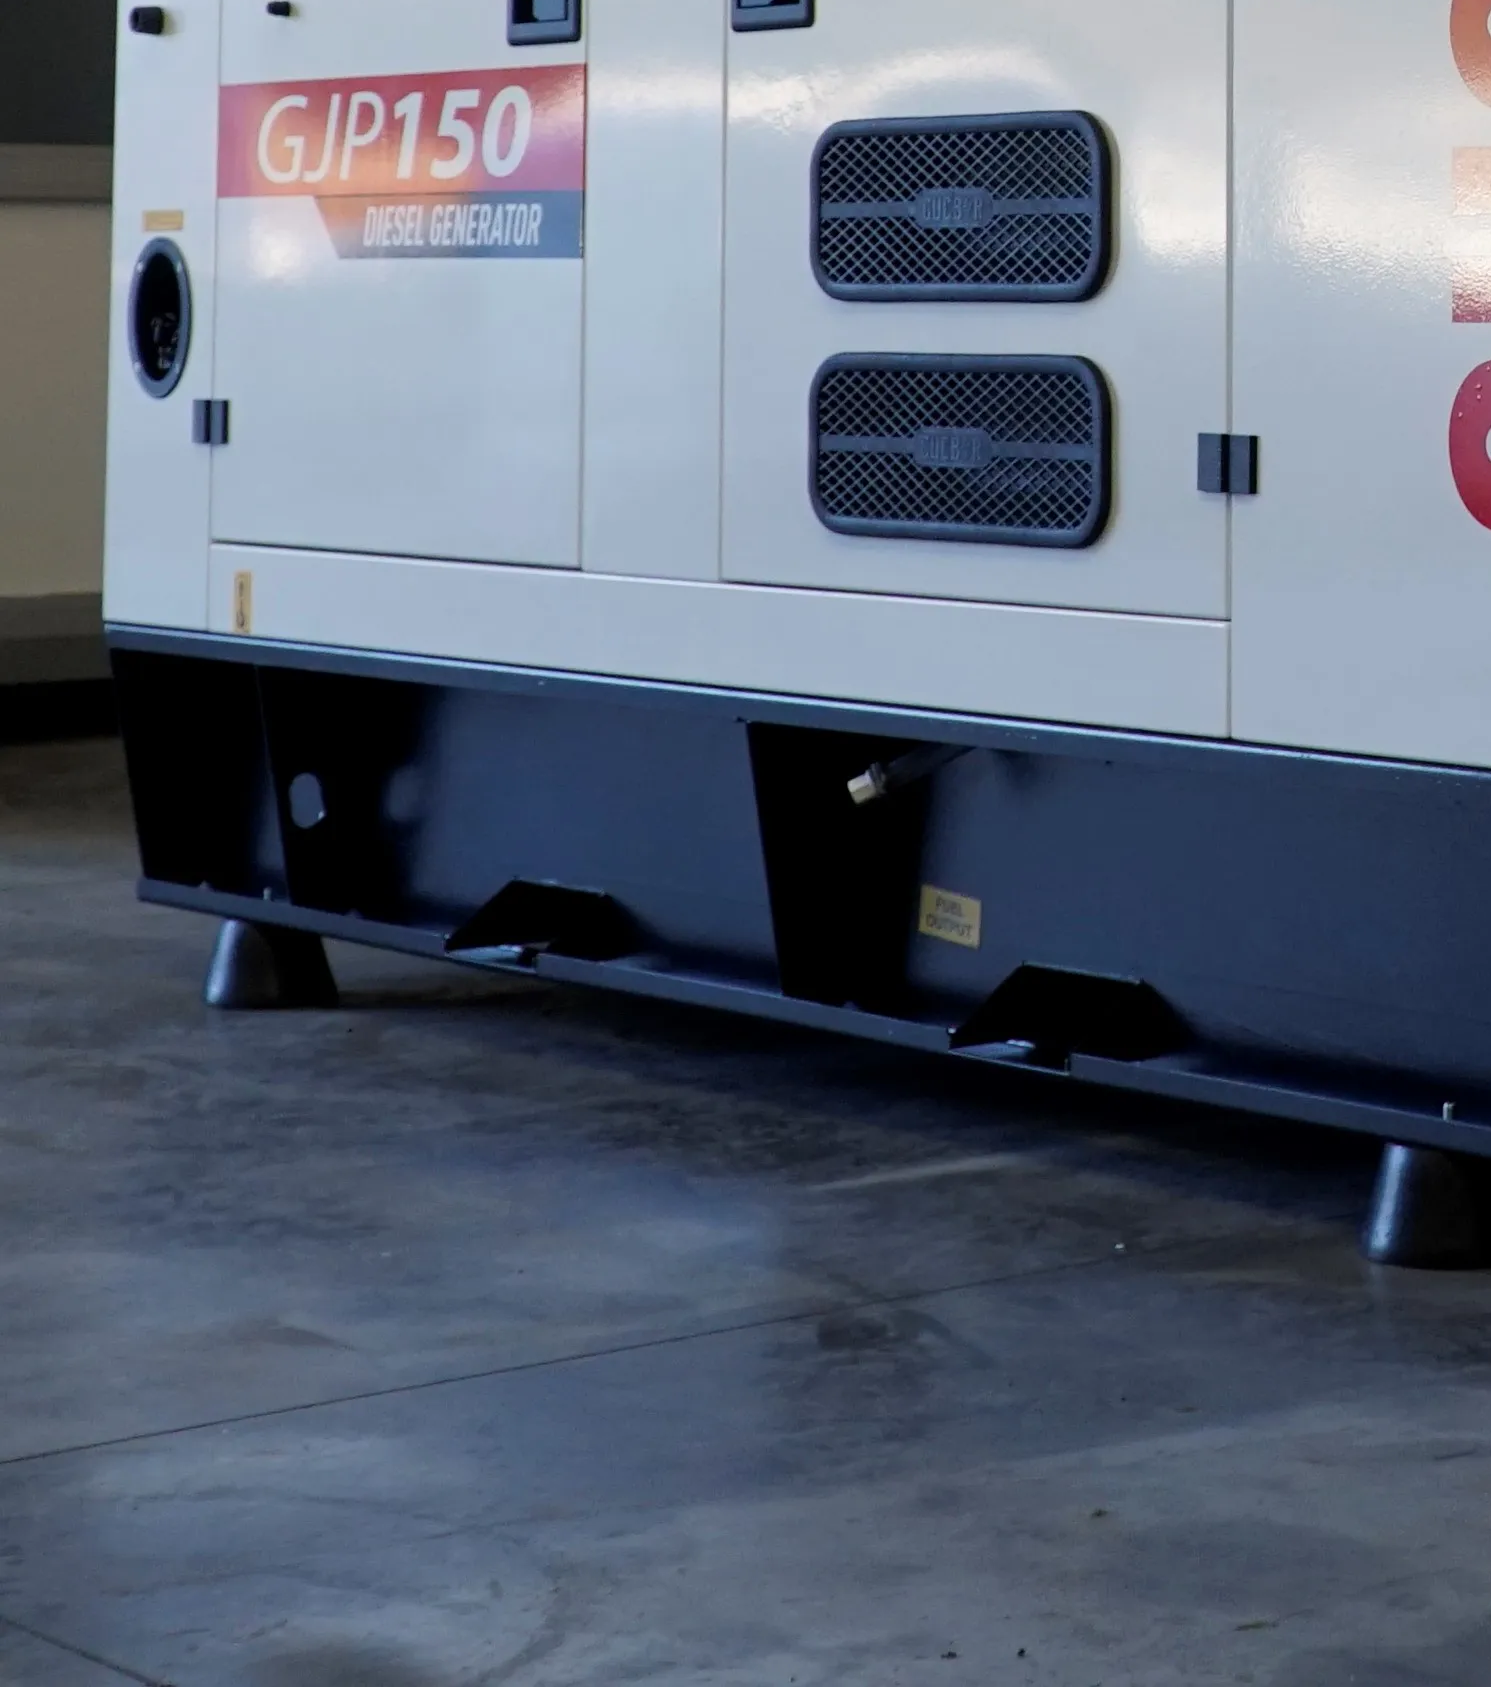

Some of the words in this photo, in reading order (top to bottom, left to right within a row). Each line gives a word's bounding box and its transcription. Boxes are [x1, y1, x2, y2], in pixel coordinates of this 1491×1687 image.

[257, 84, 533, 184] GJP150
[362, 206, 425, 248] DIESEL
[429, 202, 544, 248] GENERATOR
